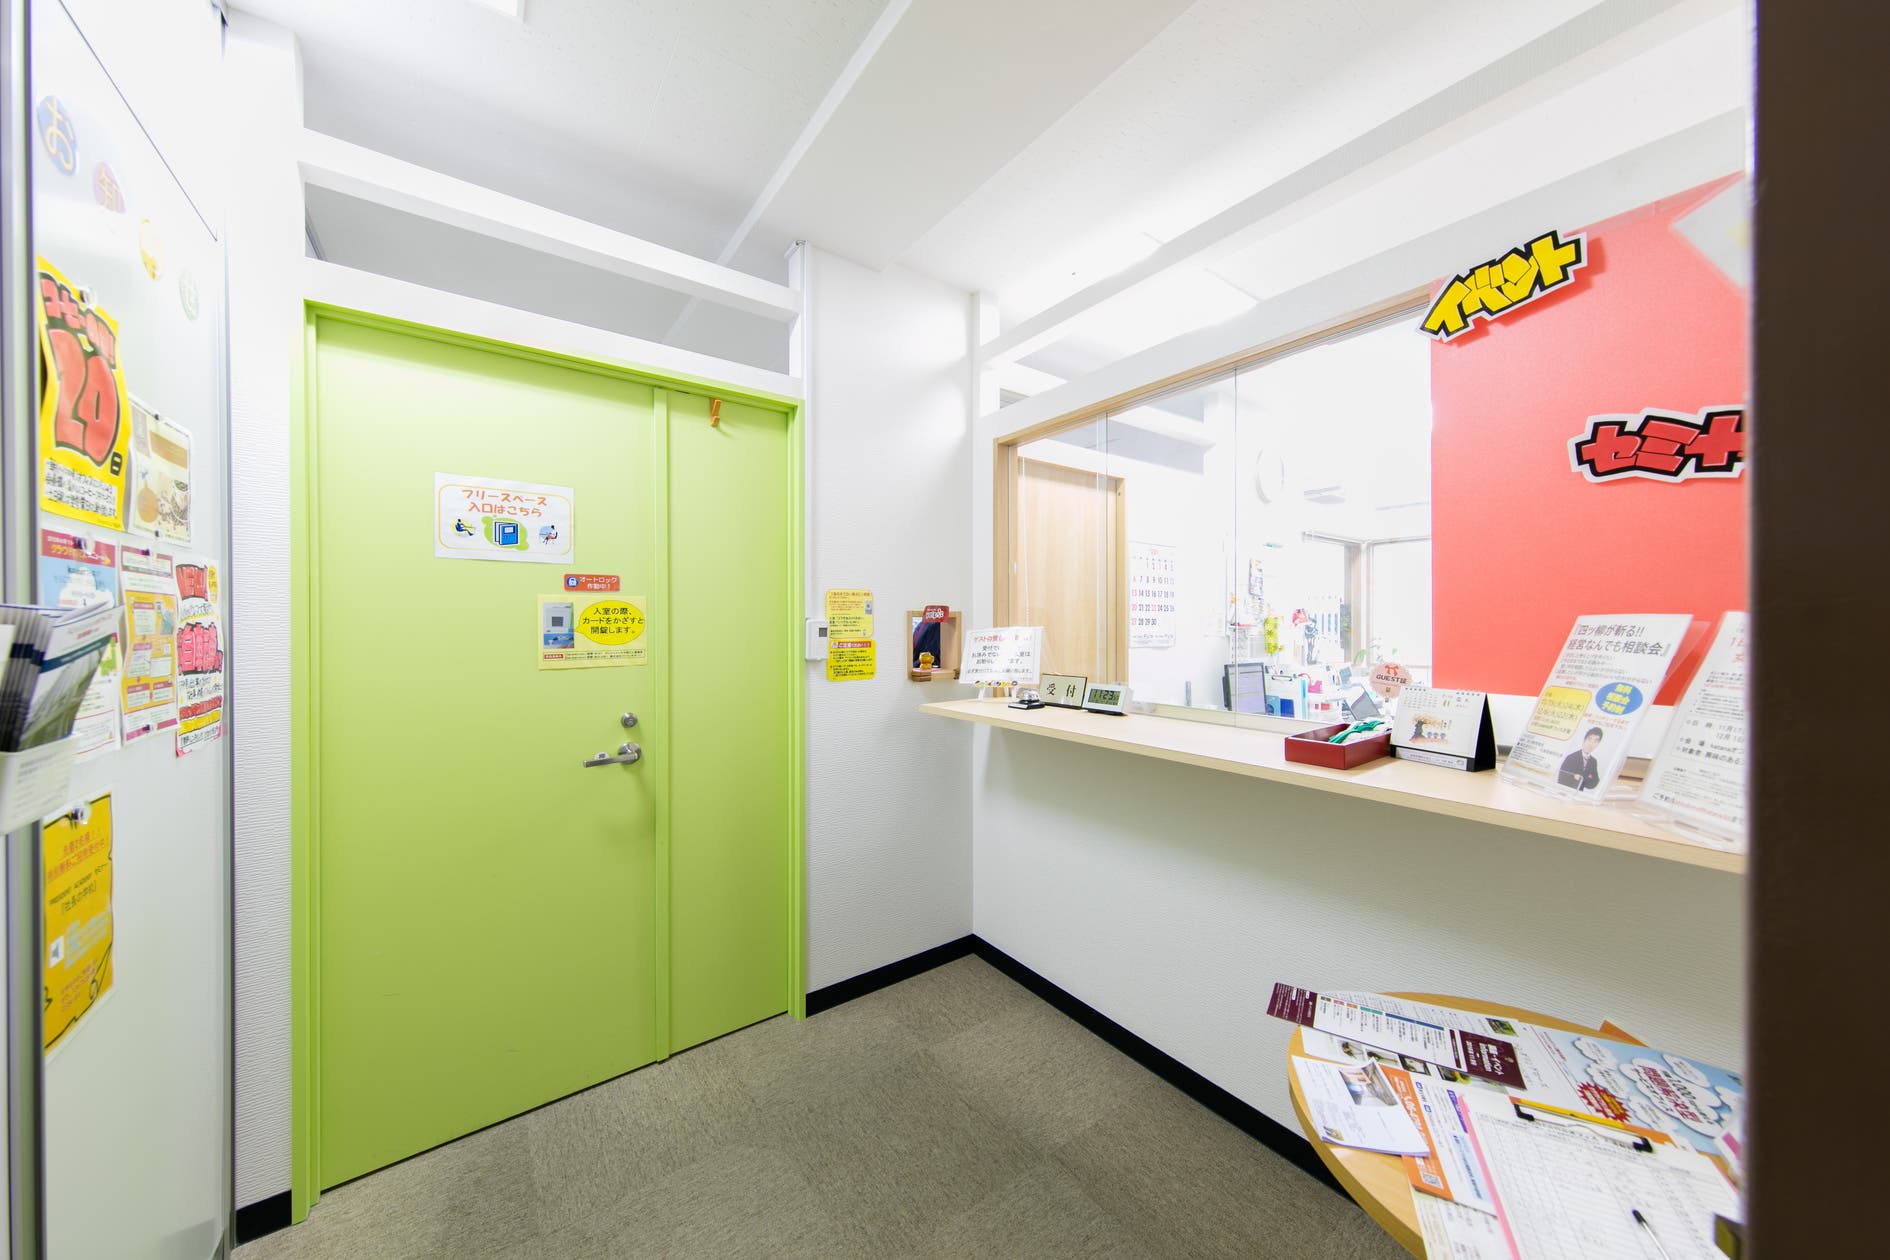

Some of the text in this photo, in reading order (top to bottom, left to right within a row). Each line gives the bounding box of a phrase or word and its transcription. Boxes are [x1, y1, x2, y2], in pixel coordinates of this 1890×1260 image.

[1421, 231, 1580, 336] イベント
[1576, 411, 1744, 476] セミナ
[462, 489, 547, 506] フリースペース
[468, 502, 542, 517] 入口はこちら
[1139, 589, 1144, 597] 14
[1151, 590, 1156, 598] 16
[1157, 590, 1163, 598] 17
[593, 607, 632, 616] 入室の際、
[1158, 604, 1163, 612] 24
[1164, 604, 1169, 612] 25
[582, 616, 645, 625] カードをかざすと
[1145, 618, 1150, 626] 29
[1151, 618, 1157, 626] 30
[1046, 683, 1077, 698] 受付
